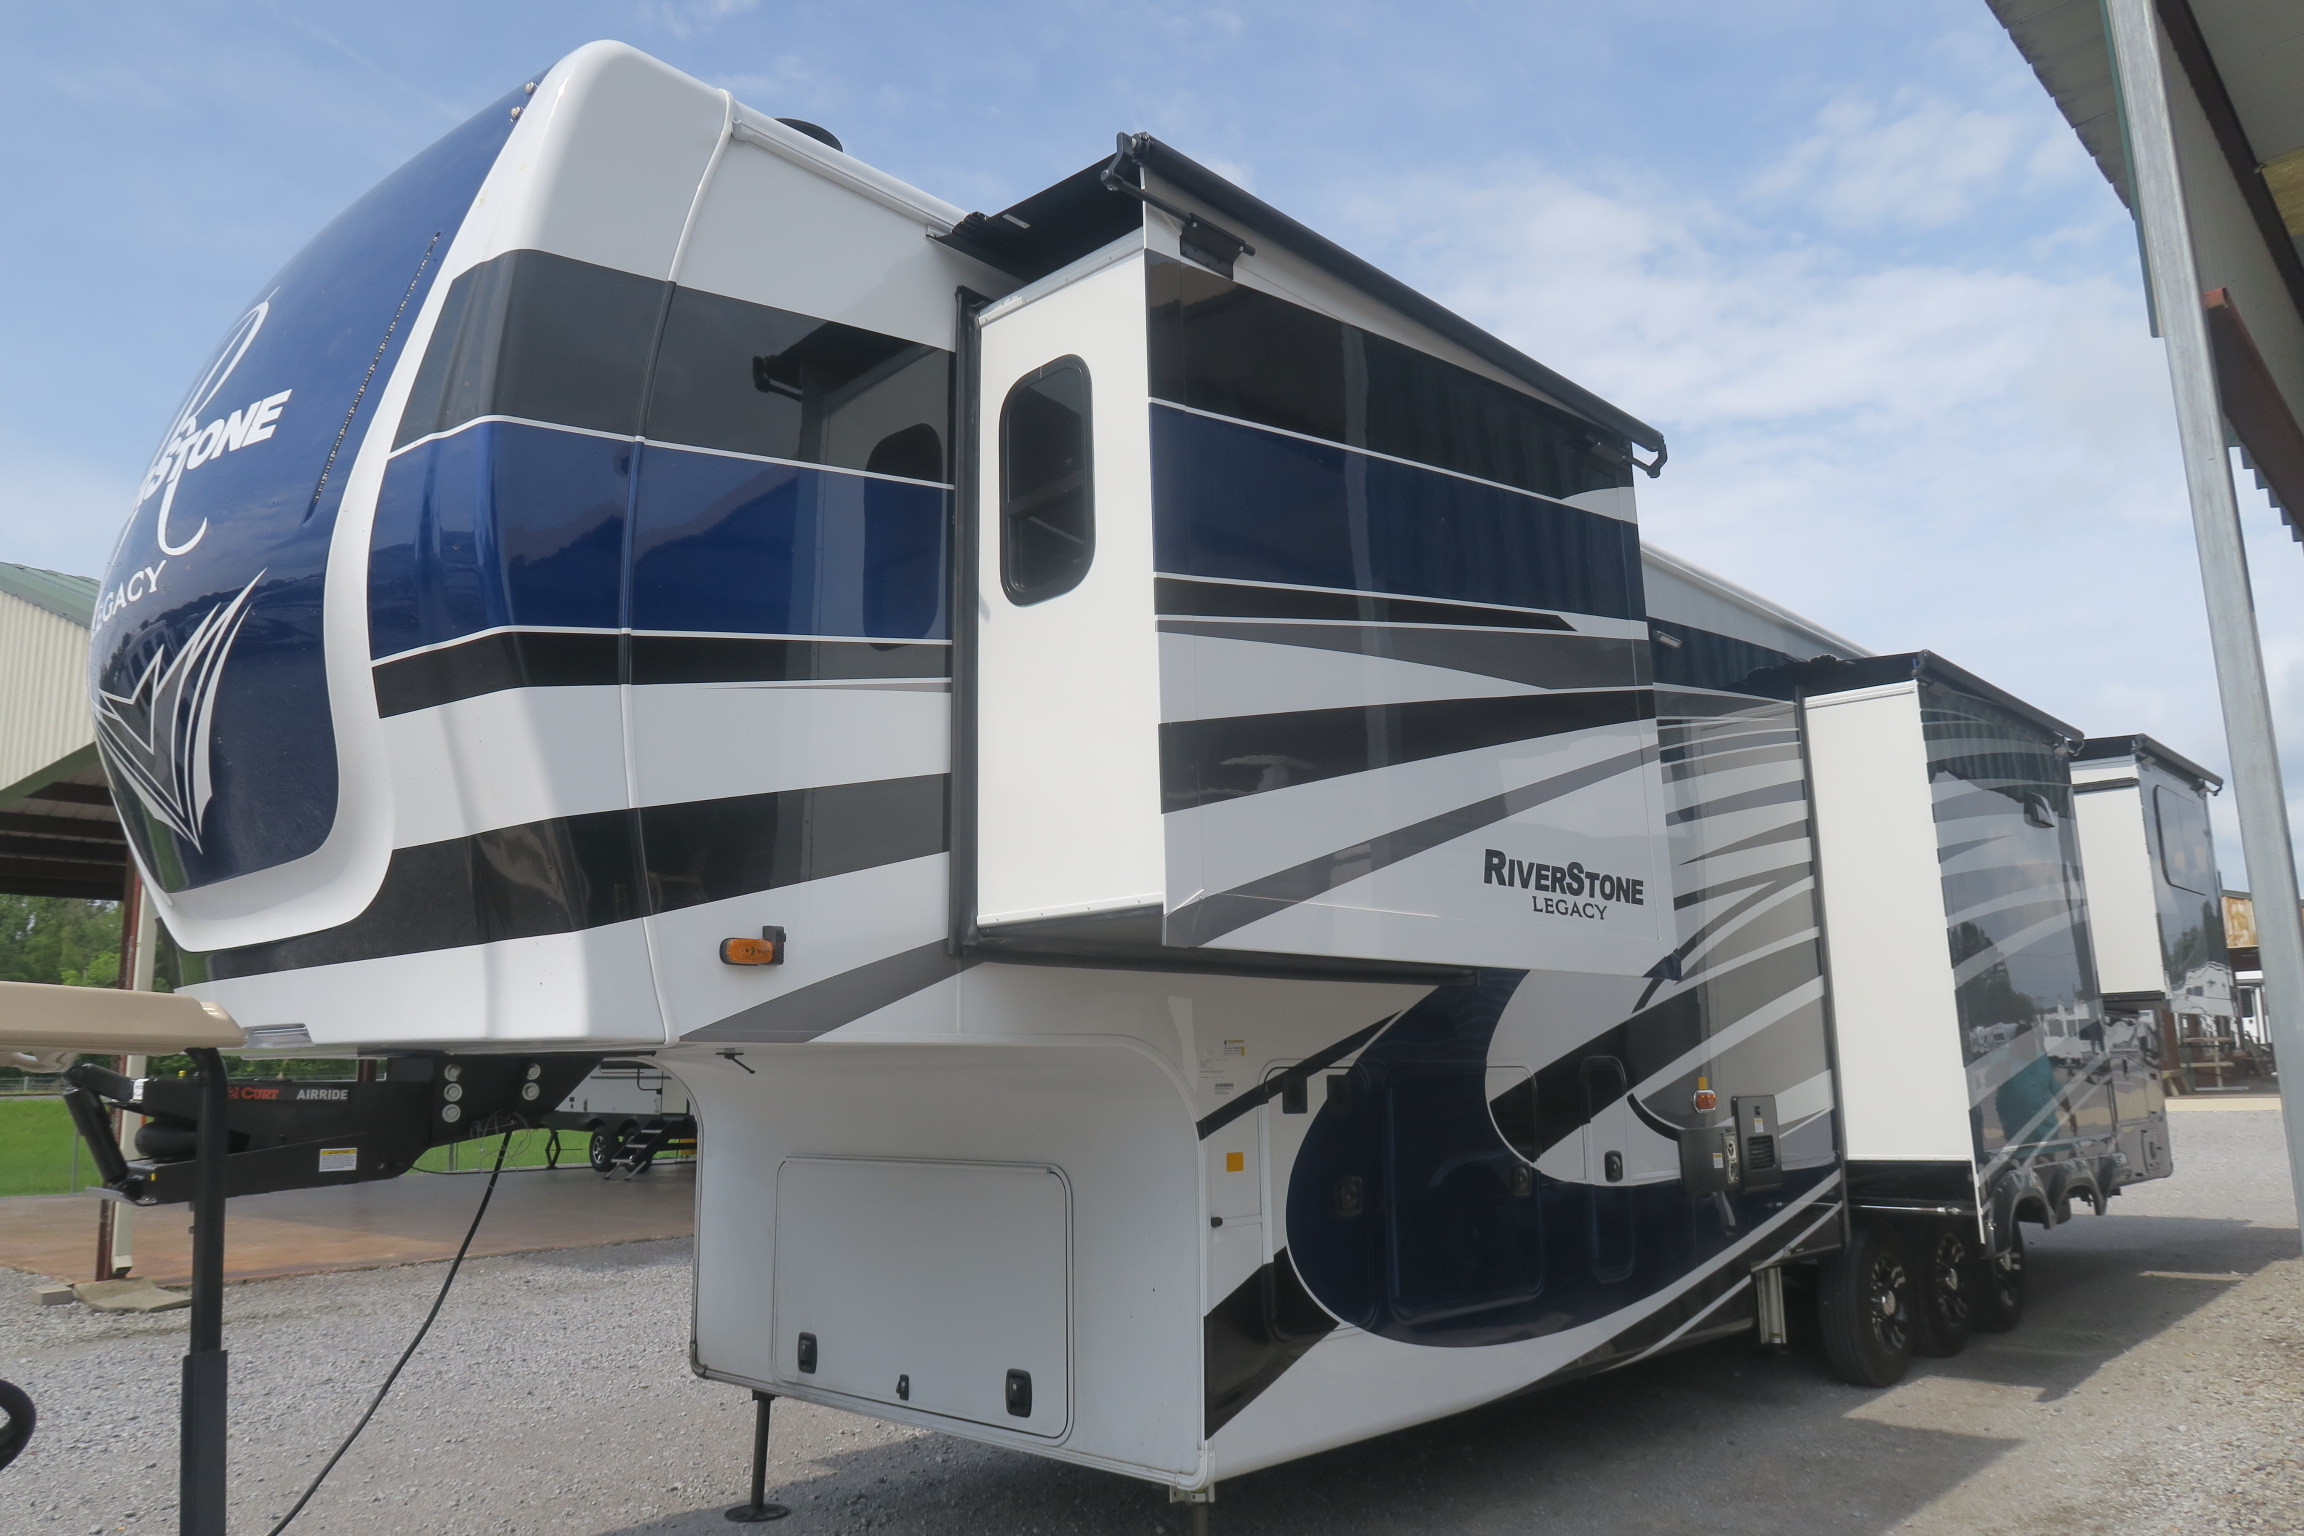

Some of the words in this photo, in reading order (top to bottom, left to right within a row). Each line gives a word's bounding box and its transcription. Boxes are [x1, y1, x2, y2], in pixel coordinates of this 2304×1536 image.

[1484, 848, 1644, 905] RIVERSTONE
[1532, 895, 1608, 920] LEGACY
[241, 1087, 280, 1100] CURT
[296, 1089, 349, 1100] AIRRIDE
